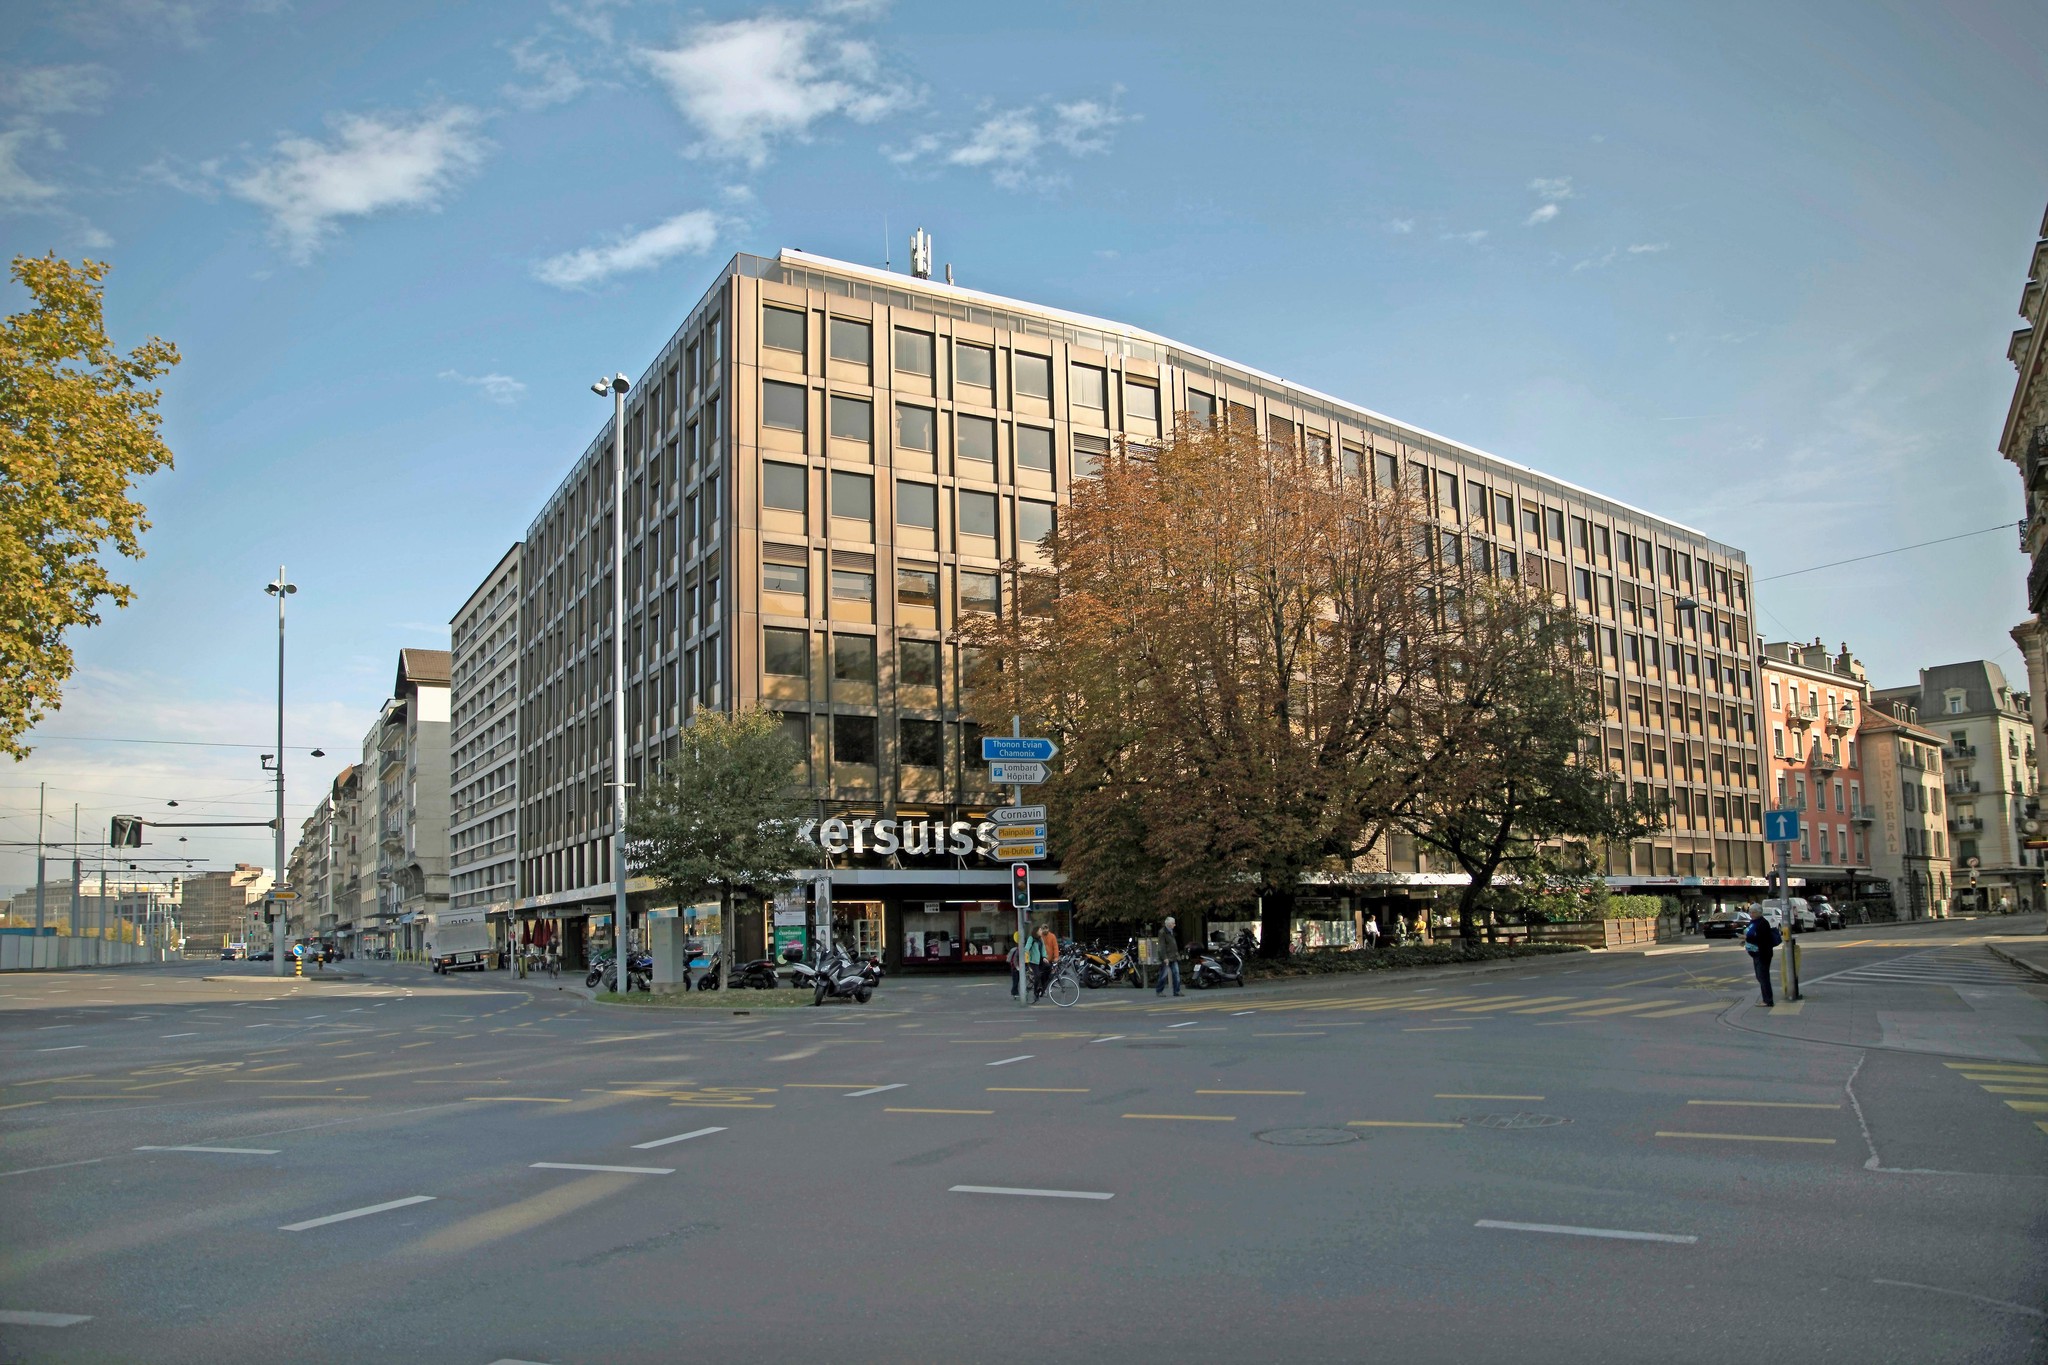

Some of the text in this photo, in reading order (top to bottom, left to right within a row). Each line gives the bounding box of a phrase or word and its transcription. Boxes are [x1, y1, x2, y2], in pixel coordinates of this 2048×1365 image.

[993, 740, 1042, 748] Thonon Evian
[999, 749, 1036, 757] Chamonix
[1007, 772, 1035, 782] Hôpital
[1000, 809, 1042, 820] Cornavin
[999, 827, 1035, 838] Plainpalais
[998, 846, 1035, 856] Uni-Dufour
